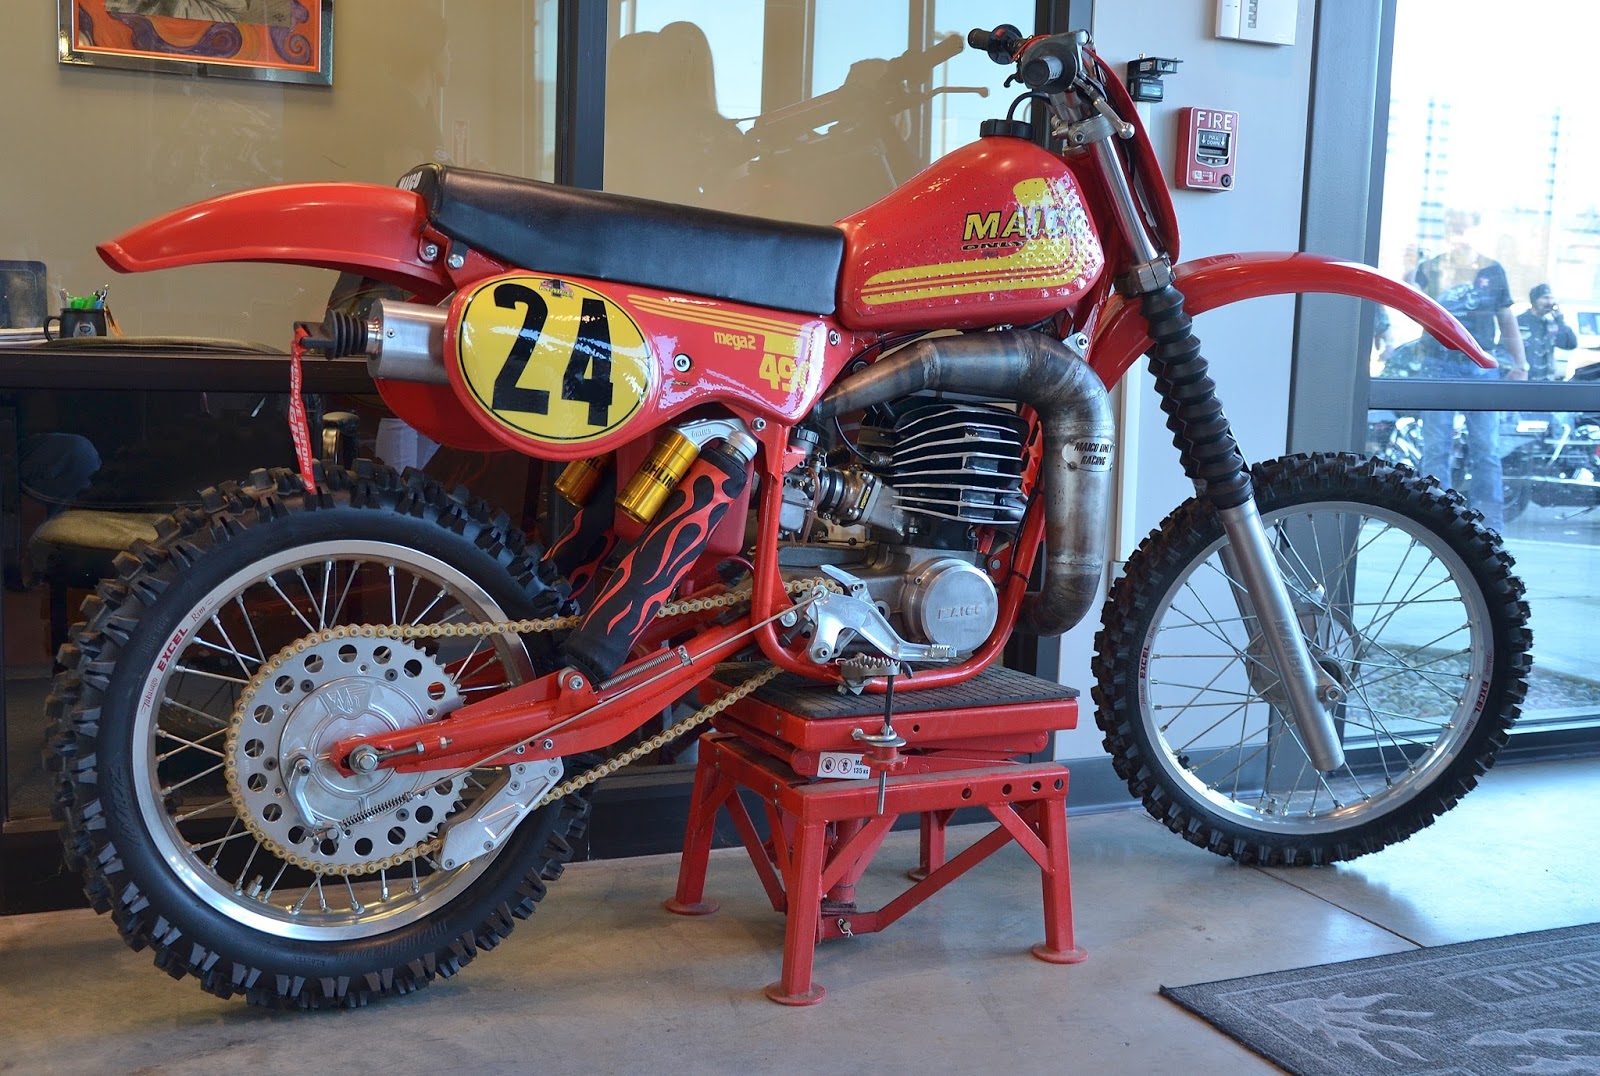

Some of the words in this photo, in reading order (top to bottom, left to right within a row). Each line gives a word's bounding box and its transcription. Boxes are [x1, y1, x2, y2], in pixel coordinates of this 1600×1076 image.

[1196, 110, 1233, 131] FIRE
[491, 283, 614, 427] 24
[294, 358, 303, 419] REMOVE
[298, 421, 311, 475] BEFORE
[1074, 442, 1100, 452] MAICO
[1080, 455, 1106, 466] RACING
[156, 627, 188, 672] EXCEL
[191, 606, 206, 622] Rim
[1139, 644, 1150, 679] EXCEL
[1473, 680, 1489, 714] EXCEL
